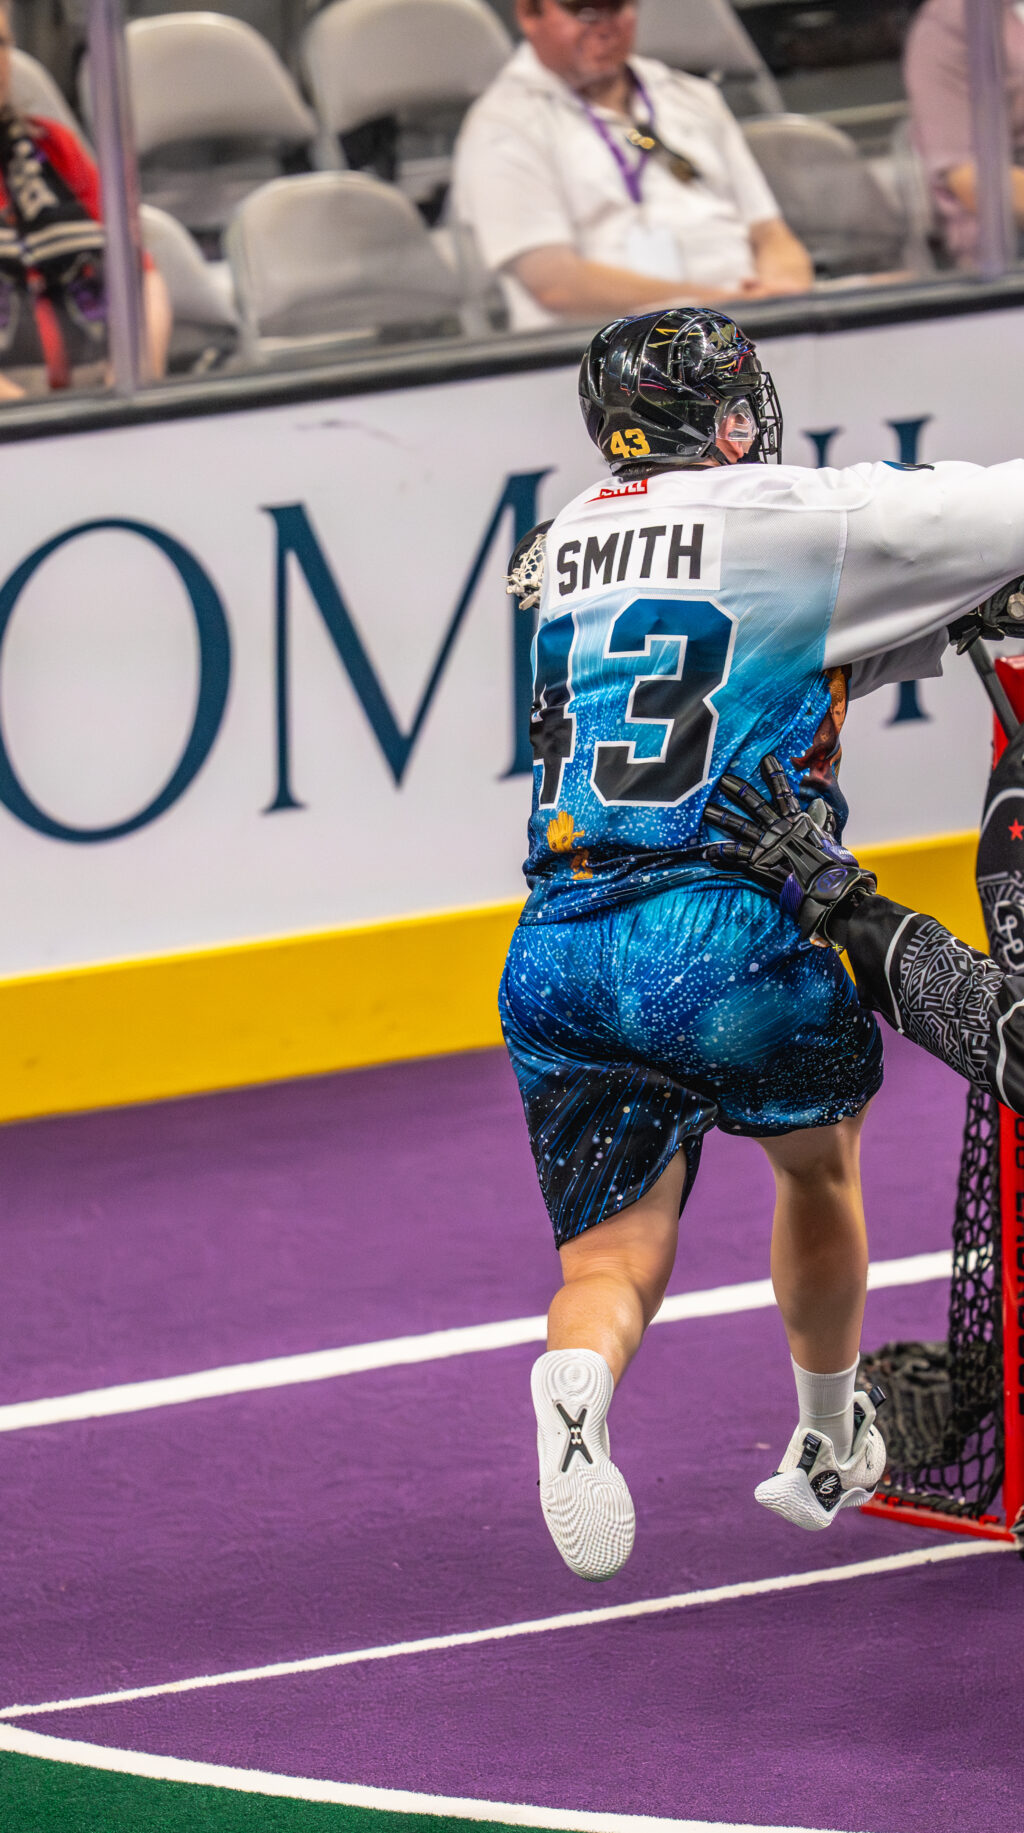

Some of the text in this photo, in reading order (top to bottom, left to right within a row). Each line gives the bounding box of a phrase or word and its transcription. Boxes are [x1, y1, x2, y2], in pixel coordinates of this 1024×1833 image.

[610, 428, 651, 458] 43
[556, 523, 705, 597] SMITH
[530, 595, 740, 810] 43
